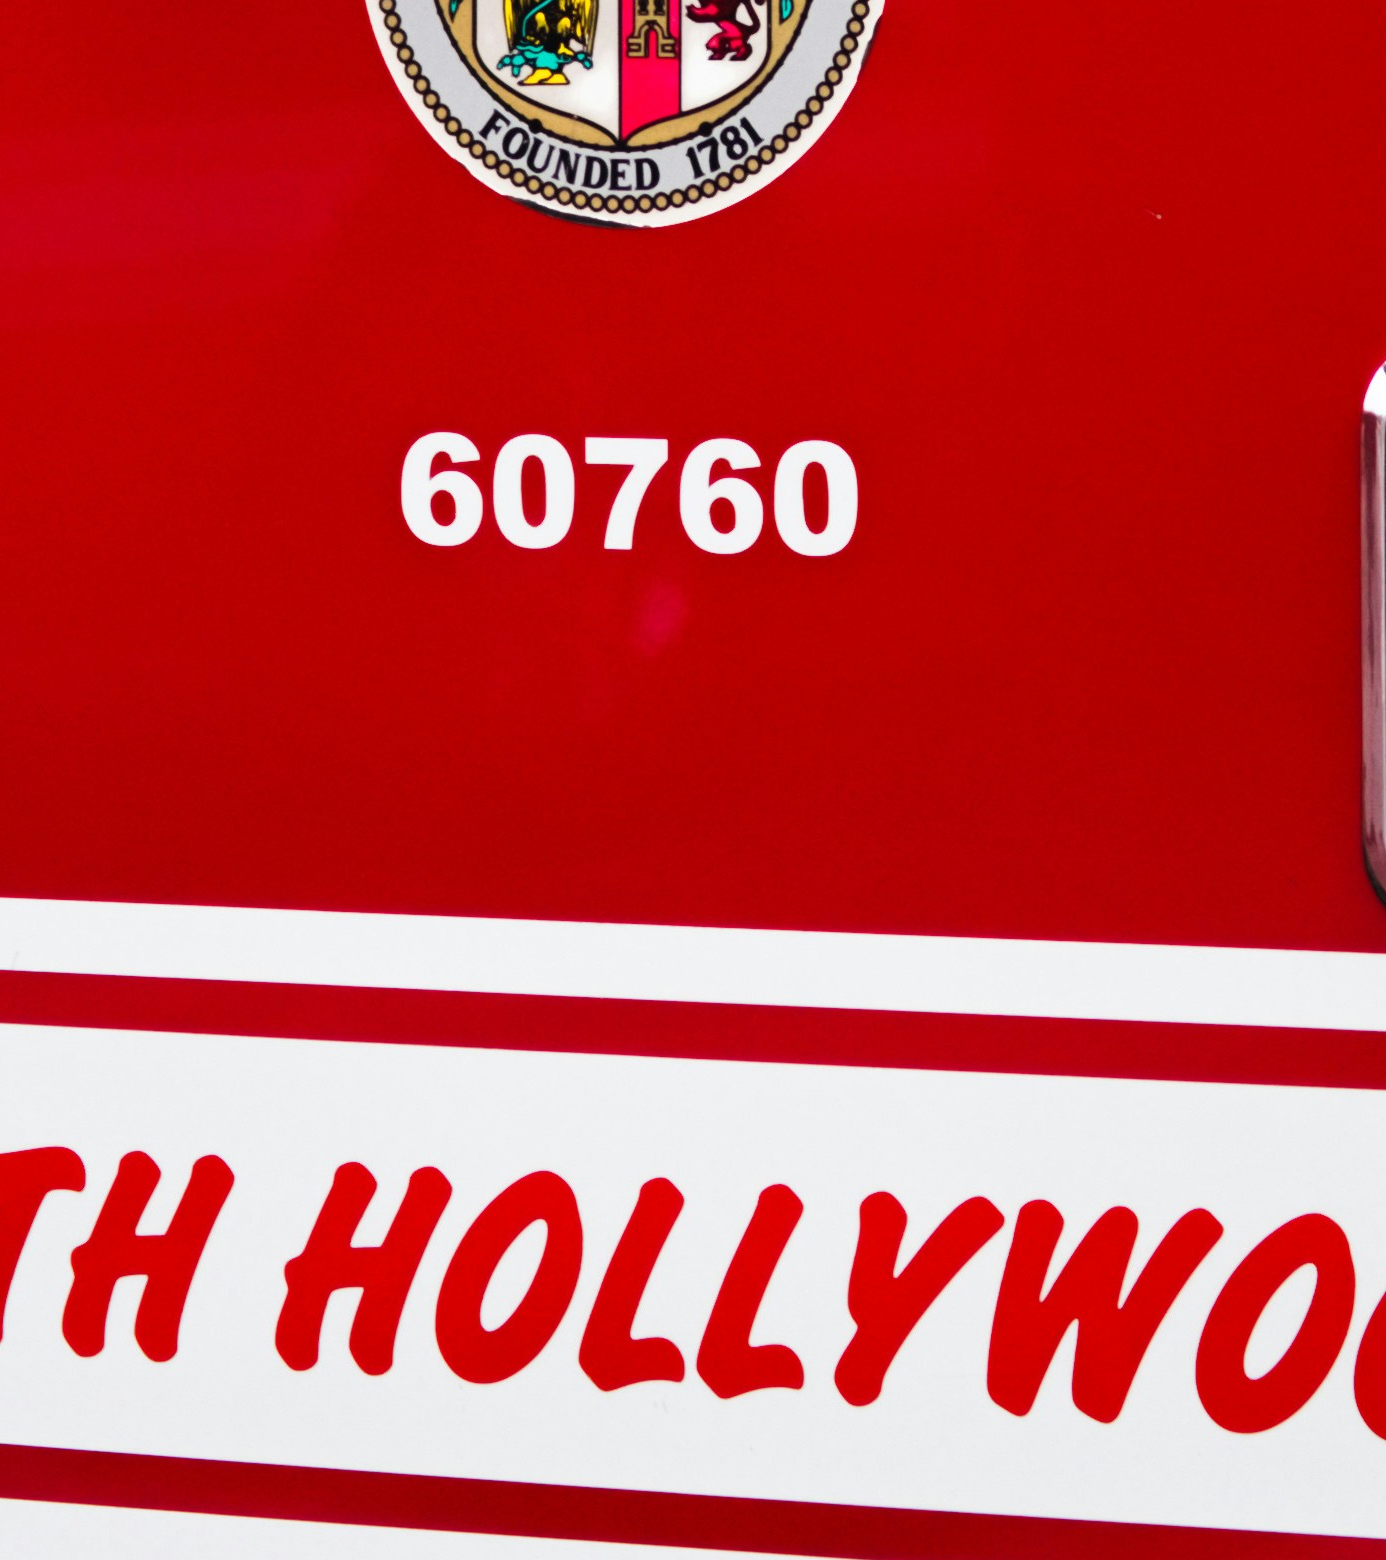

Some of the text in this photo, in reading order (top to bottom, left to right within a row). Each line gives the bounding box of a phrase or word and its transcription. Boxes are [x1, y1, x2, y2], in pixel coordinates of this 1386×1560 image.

[478, 109, 764, 192] FOUNDED 1781
[400, 431, 859, 557] 60760
